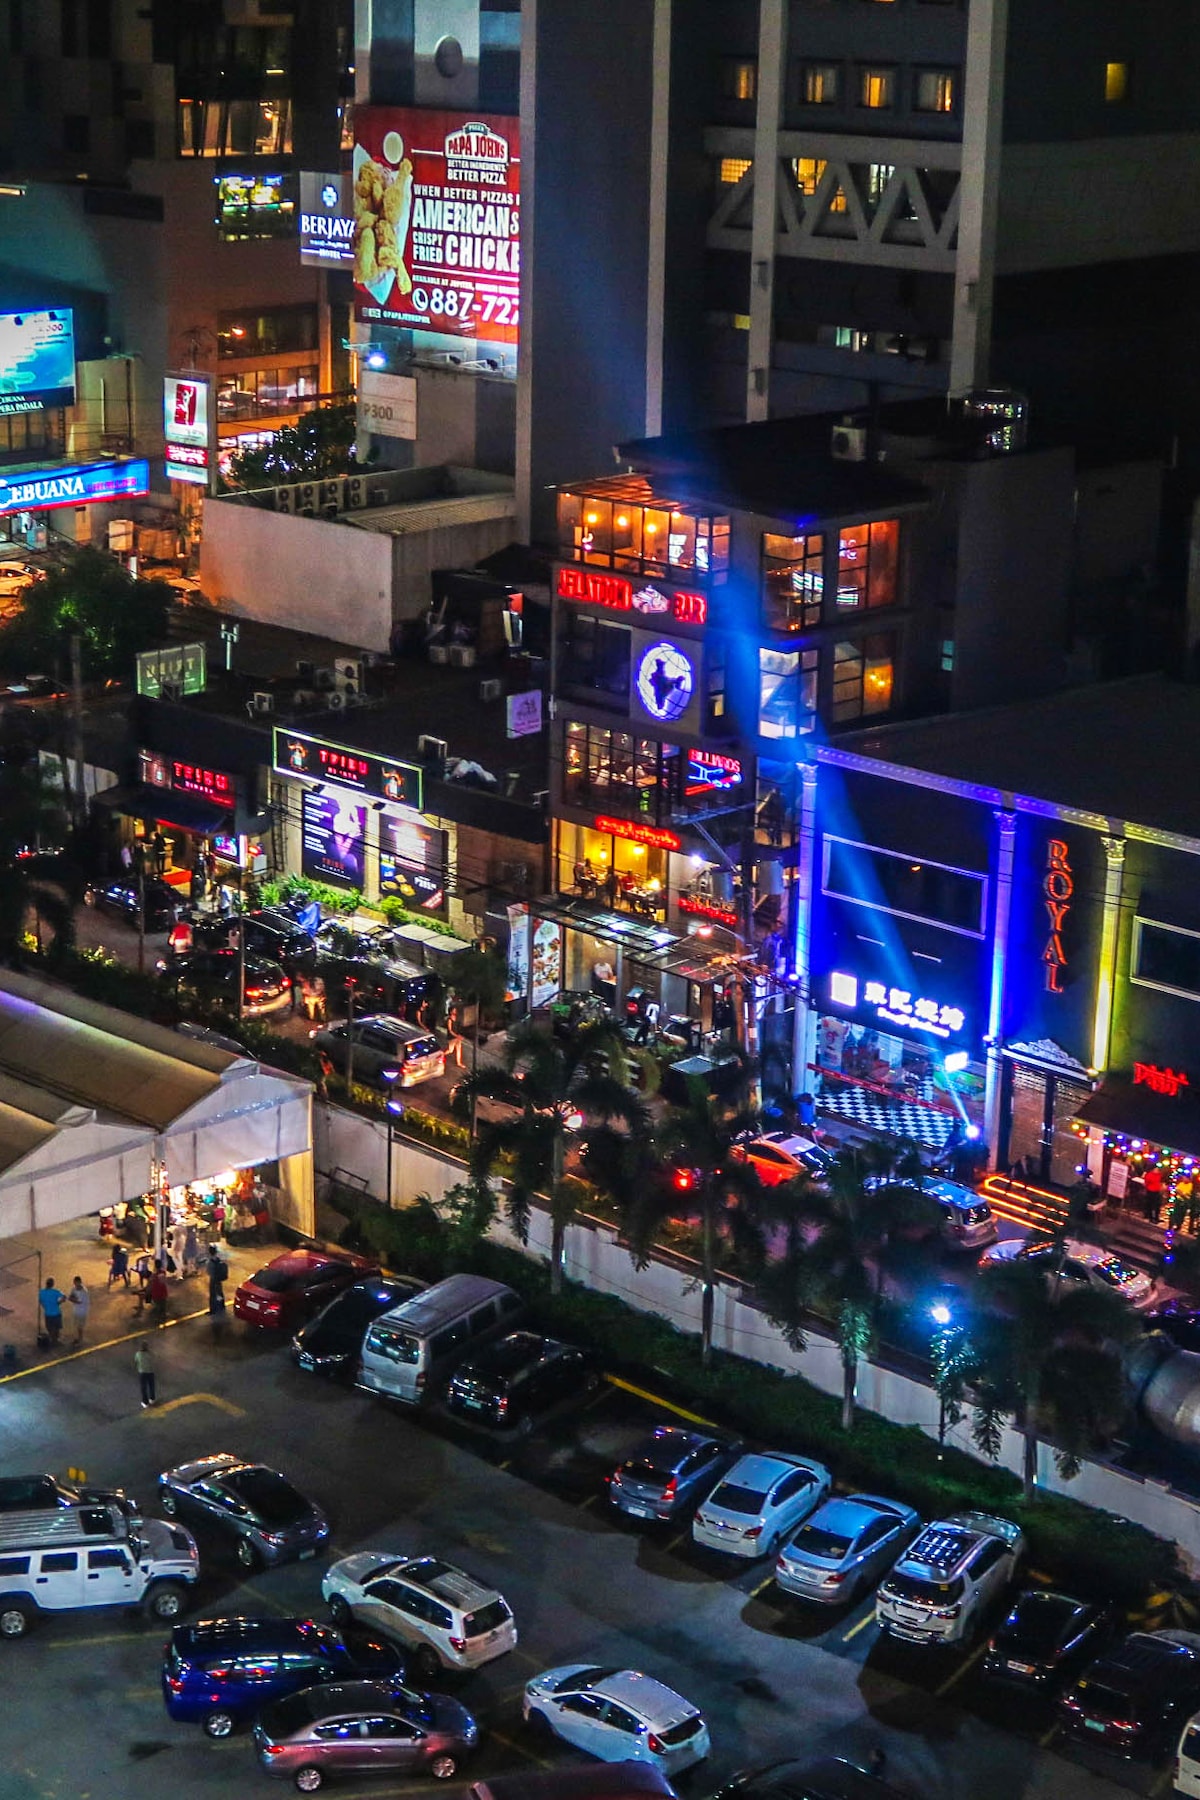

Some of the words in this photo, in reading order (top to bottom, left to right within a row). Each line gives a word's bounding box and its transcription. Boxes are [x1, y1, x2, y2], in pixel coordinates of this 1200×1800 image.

[448, 134, 473, 157] PAPA
[447, 159, 469, 168] BETTER
[447, 168, 478, 182] BETTER
[480, 171, 507, 185] PIZZA.
[413, 184, 441, 197] WHEN
[443, 187, 478, 201] BETTER
[481, 190, 514, 205] PIZZAS
[412, 231, 443, 247] CRISPY
[412, 244, 443, 264] FRIED
[363, 403, 394, 421] P300
[1042, 838, 1074, 994] ROYAL
